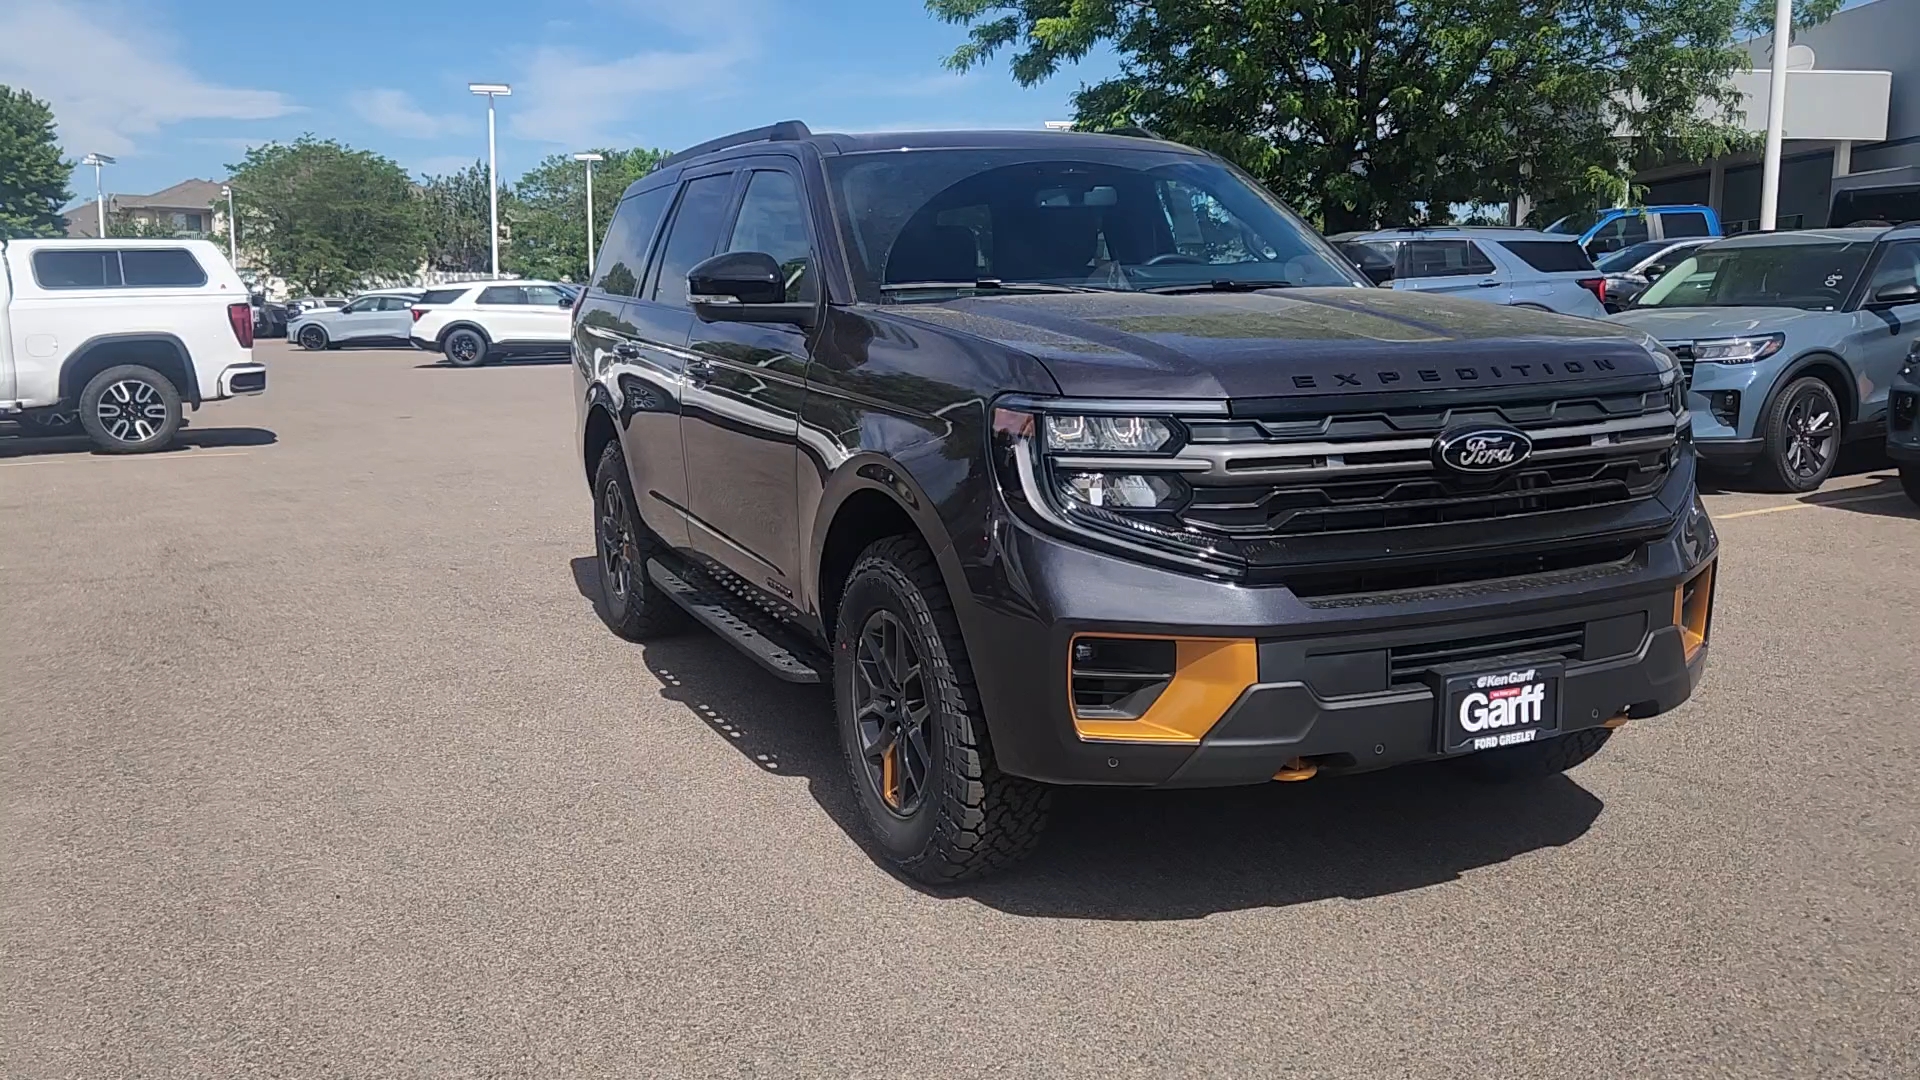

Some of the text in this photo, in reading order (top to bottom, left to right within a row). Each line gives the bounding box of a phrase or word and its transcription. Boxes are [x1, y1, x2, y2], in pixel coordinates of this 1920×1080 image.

[1291, 359, 1616, 389] EXPEDITION
[1460, 436, 1516, 466] Ford
[1460, 683, 1545, 732] Garff
[1474, 729, 1537, 750] FORD GREELEY
